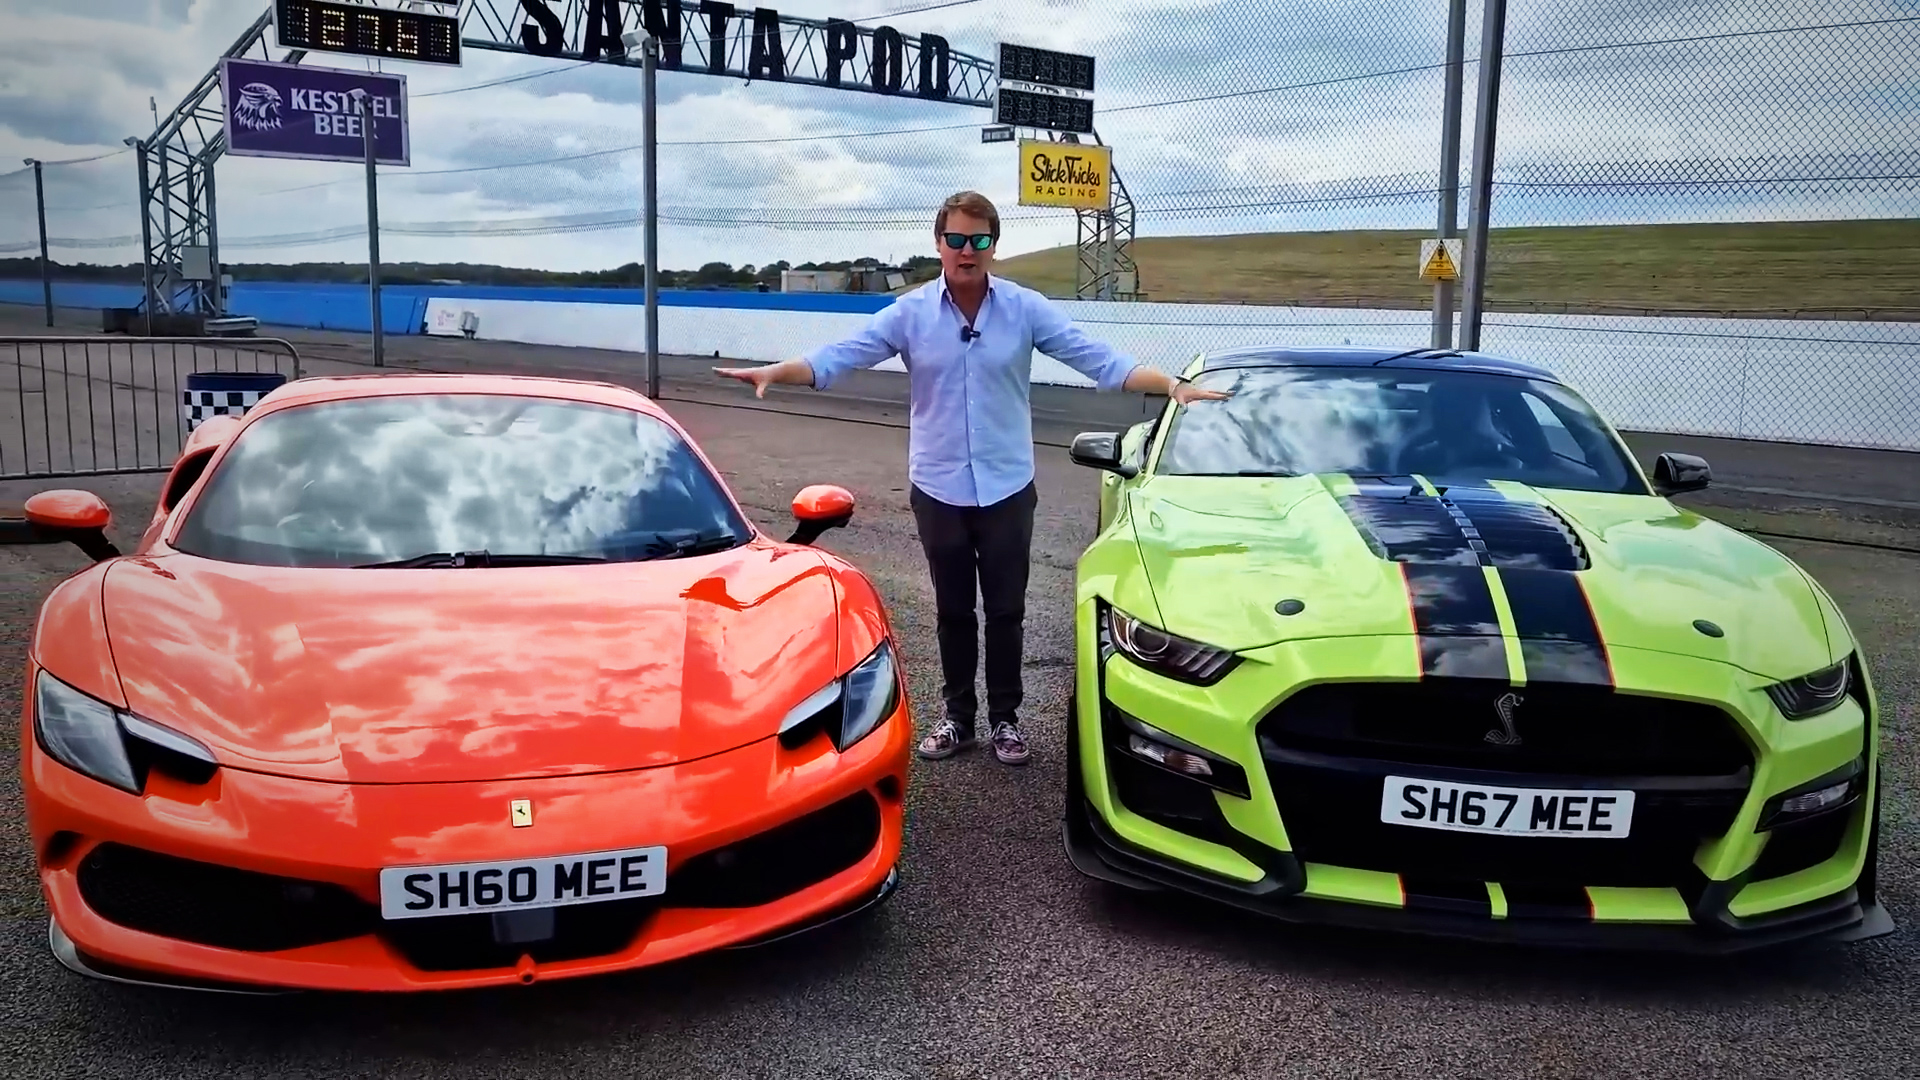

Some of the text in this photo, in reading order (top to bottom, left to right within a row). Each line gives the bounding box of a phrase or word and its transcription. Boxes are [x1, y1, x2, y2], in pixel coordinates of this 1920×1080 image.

[521, 0, 950, 99] SANTA POD
[1031, 153, 1101, 186] Slick Tricks
[1035, 185, 1097, 198] RACING
[1400, 784, 1617, 832] SH67 MEE
[403, 855, 649, 910] SH60 MEE
